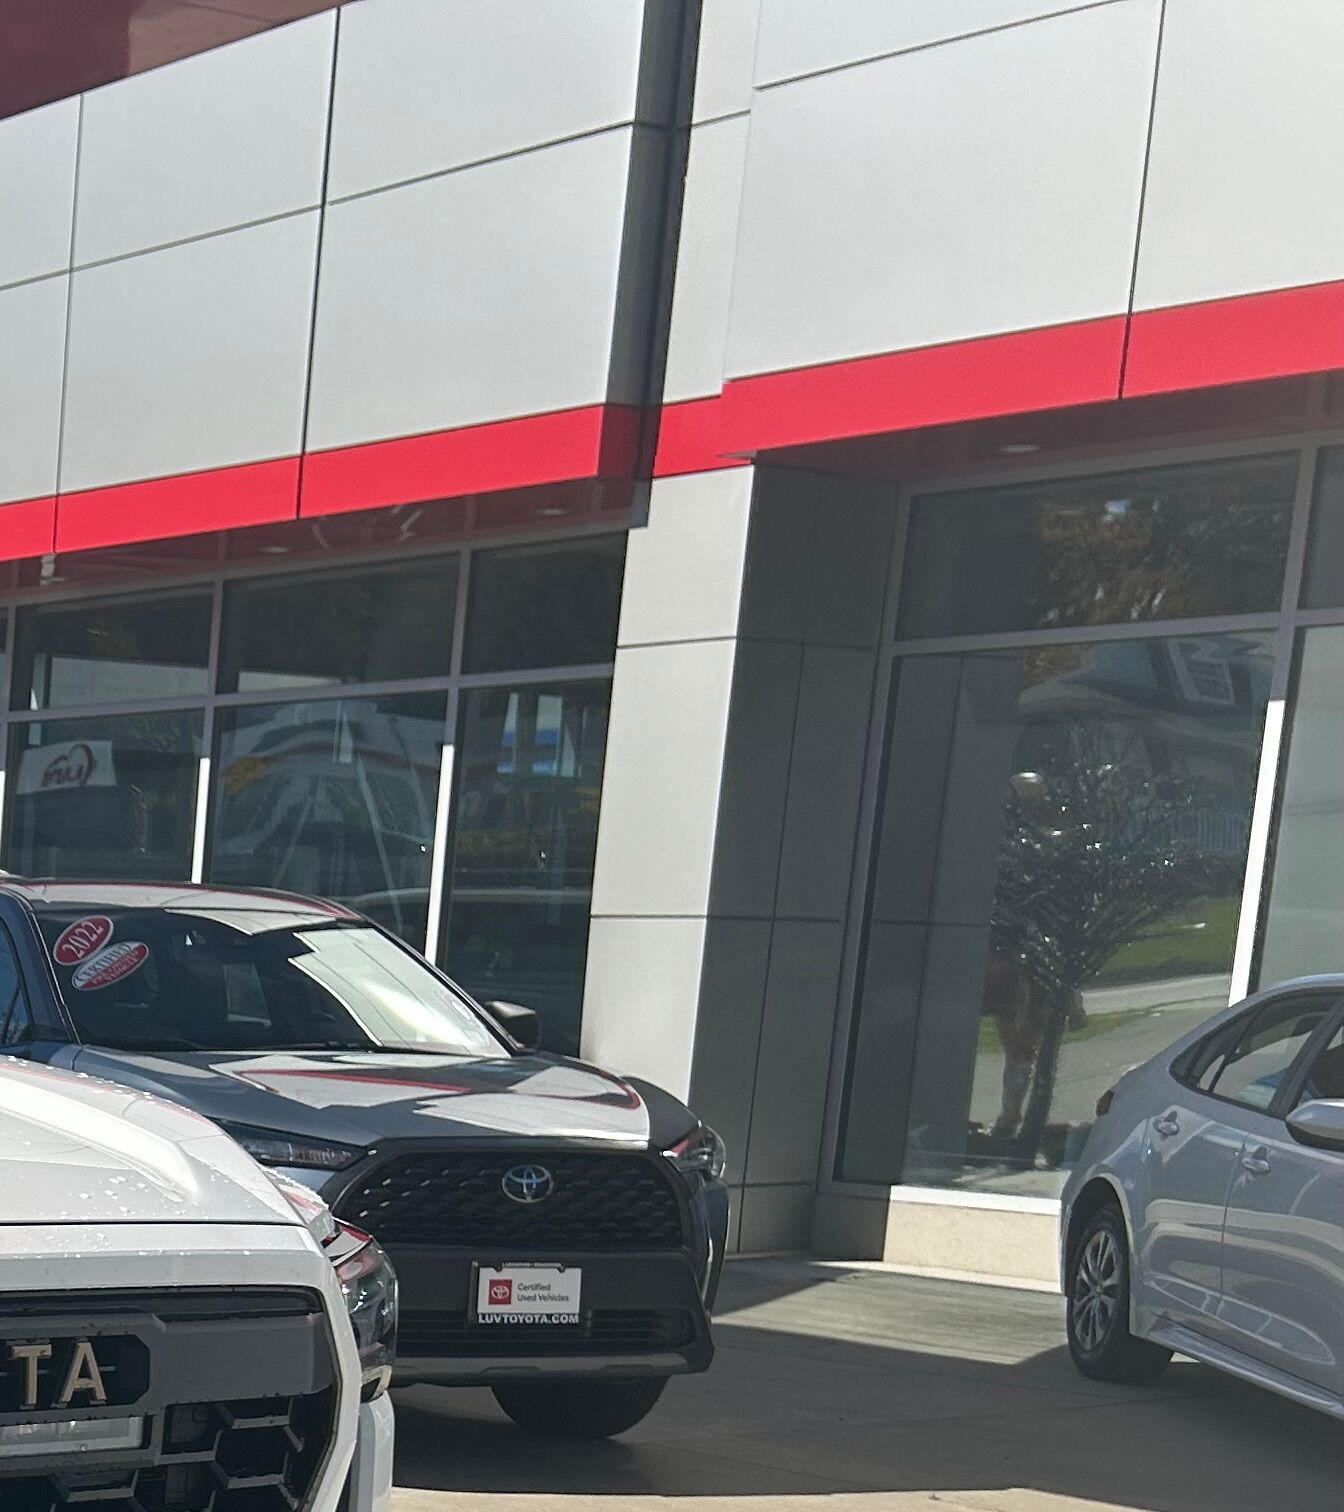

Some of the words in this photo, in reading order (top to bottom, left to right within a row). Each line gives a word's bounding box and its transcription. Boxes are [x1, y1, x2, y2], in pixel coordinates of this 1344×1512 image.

[61, 921, 104, 958] 2022
[517, 1282, 551, 1291] Certified
[478, 1313, 579, 1324] LUVTOYOTA.COM
